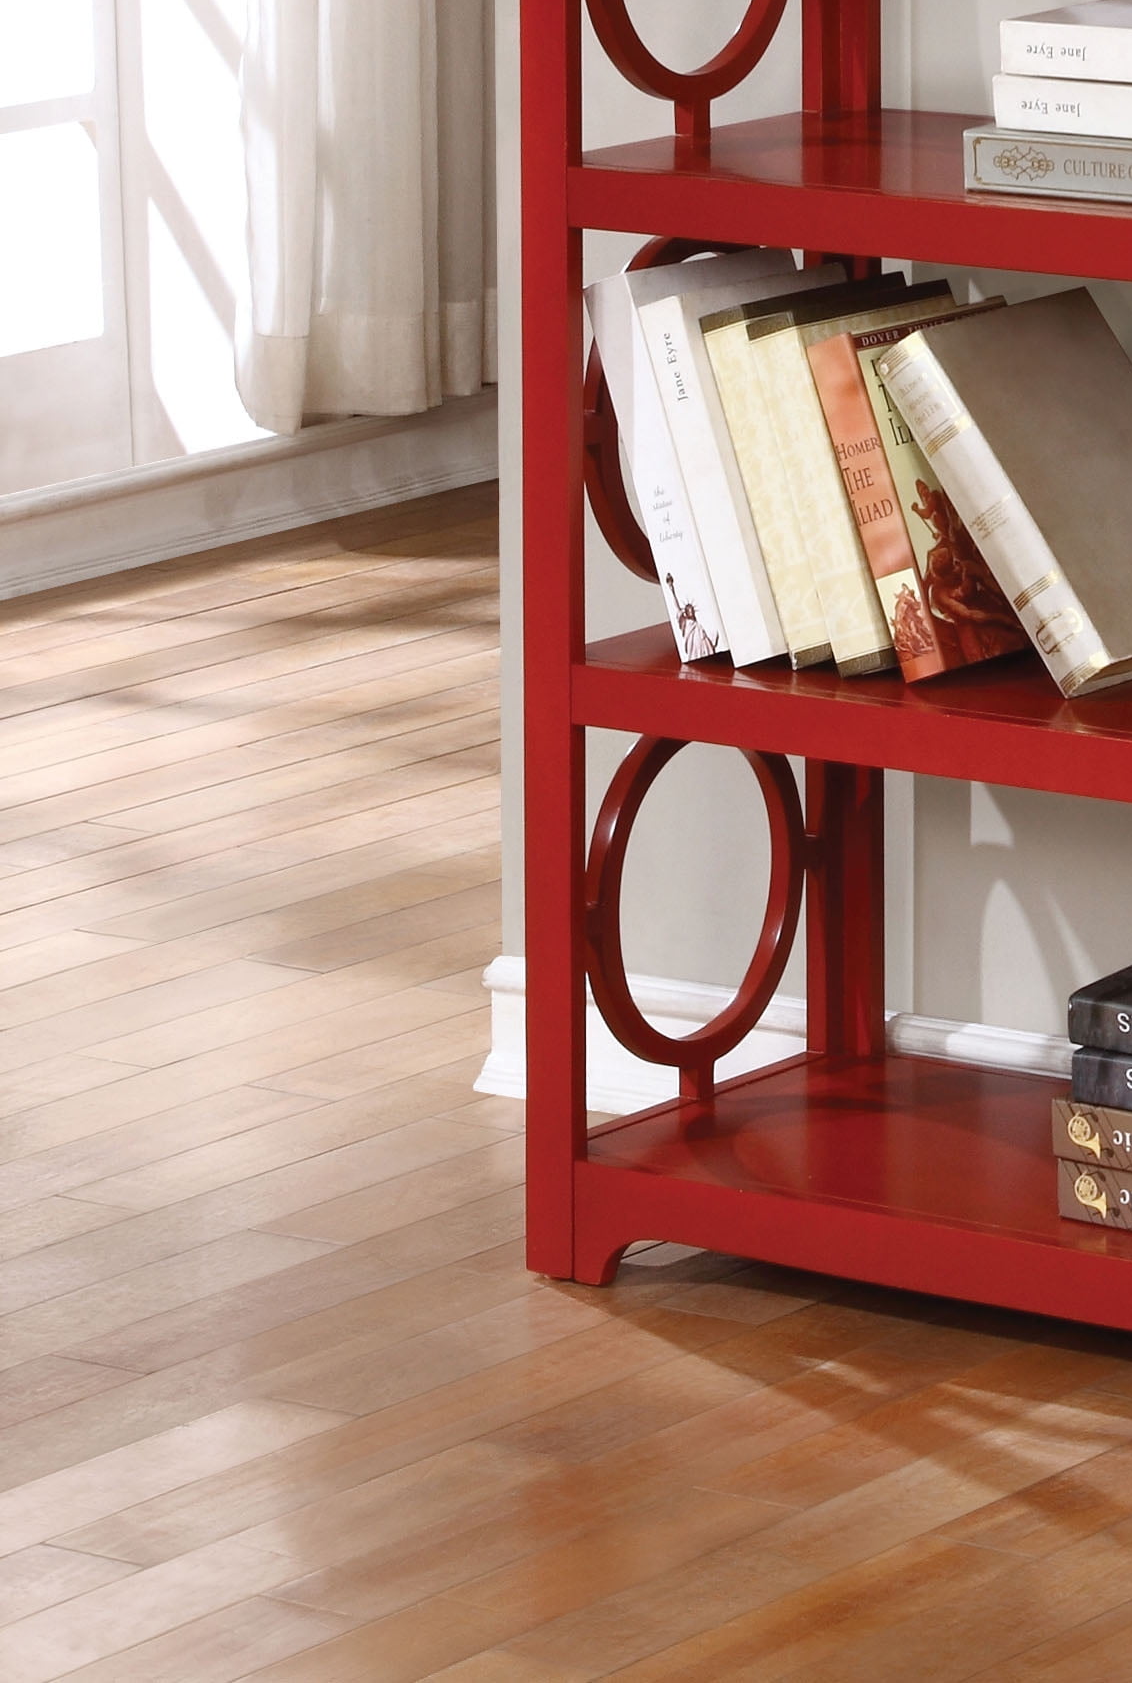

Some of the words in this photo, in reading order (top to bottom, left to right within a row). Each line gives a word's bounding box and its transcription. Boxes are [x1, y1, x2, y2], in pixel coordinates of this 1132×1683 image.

[1026, 41, 1054, 59] Eyre
[1060, 45, 1087, 62] Jane
[1021, 97, 1048, 115] Eyre
[1055, 102, 1080, 118] Jane
[1063, 159, 1126, 180] CULTURE
[663, 333, 678, 365] Eyre
[861, 330, 901, 347] DOVER
[673, 372, 689, 402] Jane
[835, 437, 881, 462] HOMER
[842, 467, 875, 495] THE
[850, 499, 894, 526] ILIAD
